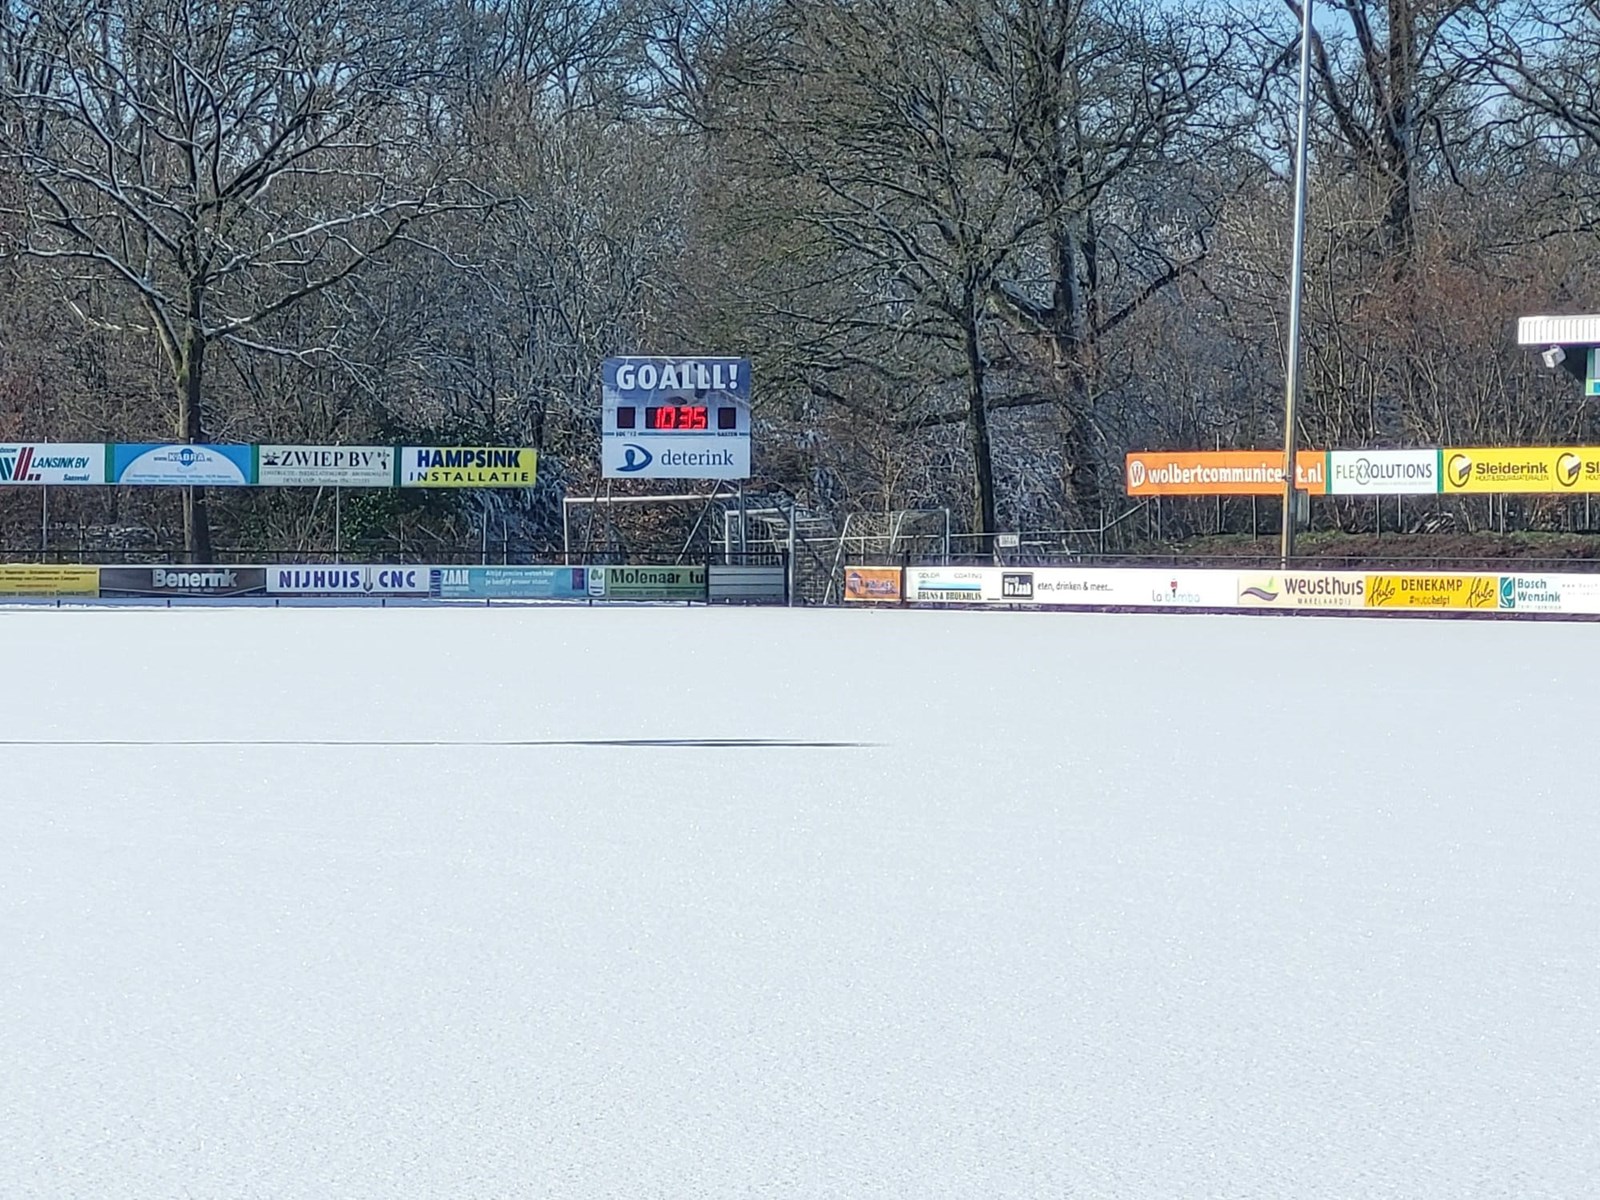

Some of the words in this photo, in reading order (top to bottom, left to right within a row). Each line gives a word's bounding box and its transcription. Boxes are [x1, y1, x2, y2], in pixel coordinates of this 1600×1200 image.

[616, 364, 739, 390] GOALLL!
[31, 457, 75, 468] LANSINK
[75, 457, 90, 468] BV
[281, 451, 344, 467] ZWIEP
[349, 451, 374, 467] BV
[417, 449, 520, 468] HAMPSINK
[661, 449, 734, 466] deterink
[1475, 462, 1548, 475] Sleiderink
[410, 471, 529, 482] INSTALLATIE
[279, 570, 360, 588] NIJHUIS
[379, 570, 416, 588] CNC
[611, 568, 681, 584] Molenaar
[1055, 581, 1081, 591] drinken
[1082, 582, 1089, 591] &
[1401, 579, 1463, 592] DENEKAMP
[1517, 578, 1547, 589] Bosch
[1517, 590, 1561, 602] Wensink
